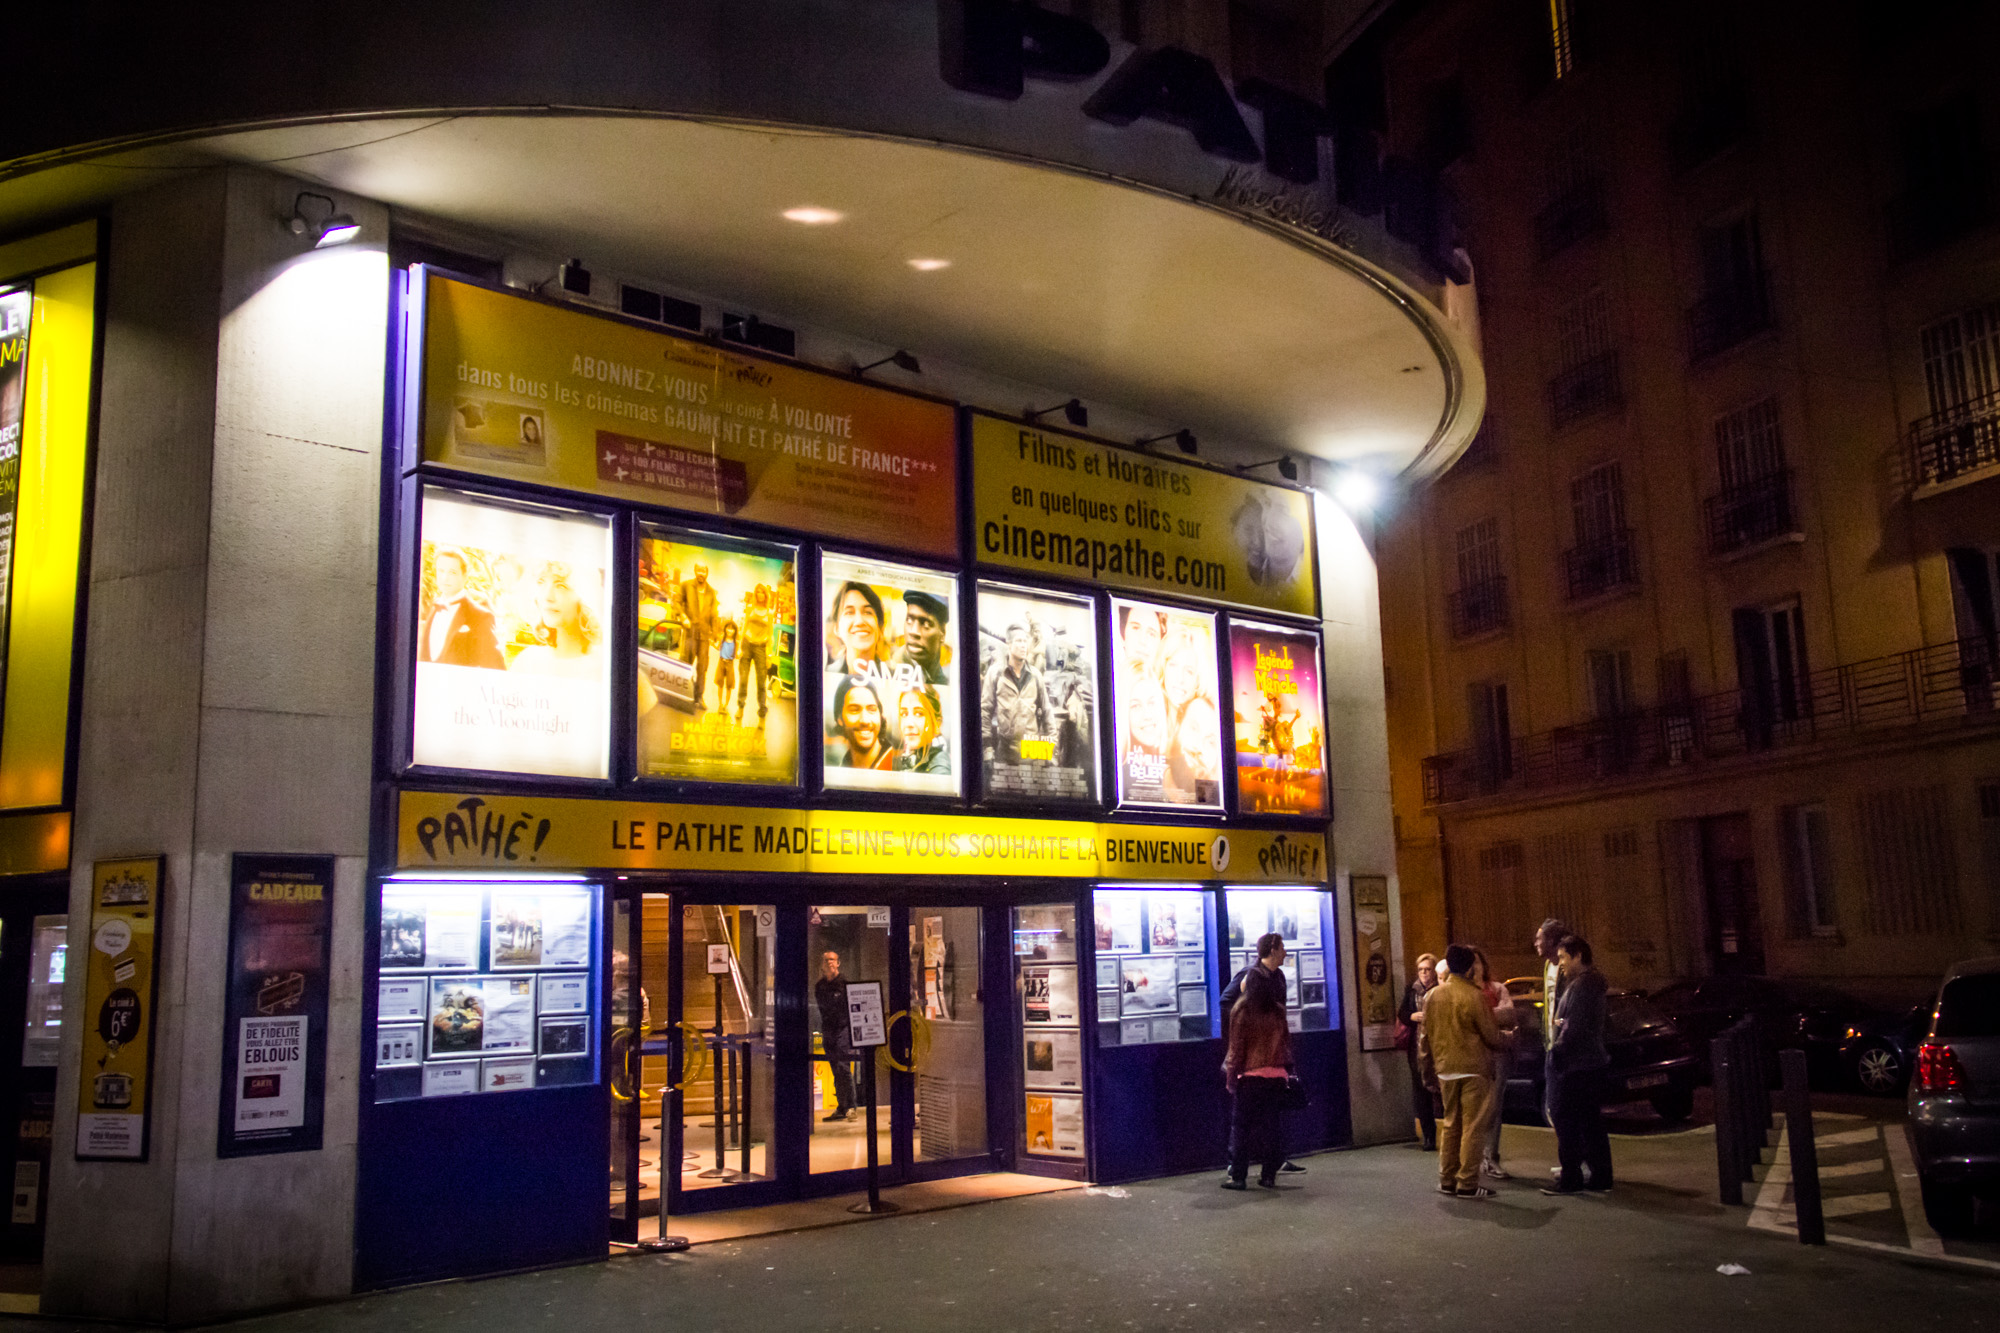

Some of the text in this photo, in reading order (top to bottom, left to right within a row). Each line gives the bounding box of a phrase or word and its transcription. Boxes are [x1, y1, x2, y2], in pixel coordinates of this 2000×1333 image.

[572, 354, 708, 405] ABONNEZ-VOUS
[737, 402, 764, 420] ciné
[769, 397, 779, 422] À
[784, 406, 853, 439] VOLONTÉ
[457, 361, 502, 389] dans
[508, 373, 548, 399] tous
[555, 381, 580, 406] les
[586, 391, 658, 423] cinémas
[748, 425, 766, 449] ET
[772, 431, 822, 460] PATHÉ
[827, 442, 848, 465] DE
[651, 458, 677, 473] FILMS
[1018, 429, 1192, 497] Films et Horaires
[657, 473, 686, 489] VILLES
[1011, 484, 1202, 540] en quelques clics sur
[983, 513, 1227, 592] cinemapathe.com
[649, 667, 690, 690] POLICE
[850, 657, 927, 694] SAMBA
[477, 685, 550, 711] Magic in
[454, 706, 571, 735] the Moonlight
[704, 713, 734, 725] ON A
[670, 732, 767, 755] BANGKOK
[733, 726, 754, 738] SUR
[1020, 739, 1056, 761] FURY
[1133, 745, 1144, 754] LA
[612, 820, 646, 850] LE
[656, 822, 745, 854] PATHE
[754, 824, 895, 858] MADELEINE
[903, 829, 961, 858] VOUS
[969, 832, 1071, 861] SOUHAITE
[1077, 836, 1099, 862] LA
[1105, 838, 1207, 866] BIENVENUE
[249, 881, 325, 902] CADEAUX
[246, 1026, 300, 1039] DE FIDELITE
[246, 1039, 263, 1048] VOUS
[264, 1038, 283, 1047] ALLEZ
[245, 1046, 300, 1064] EBLOUIS
